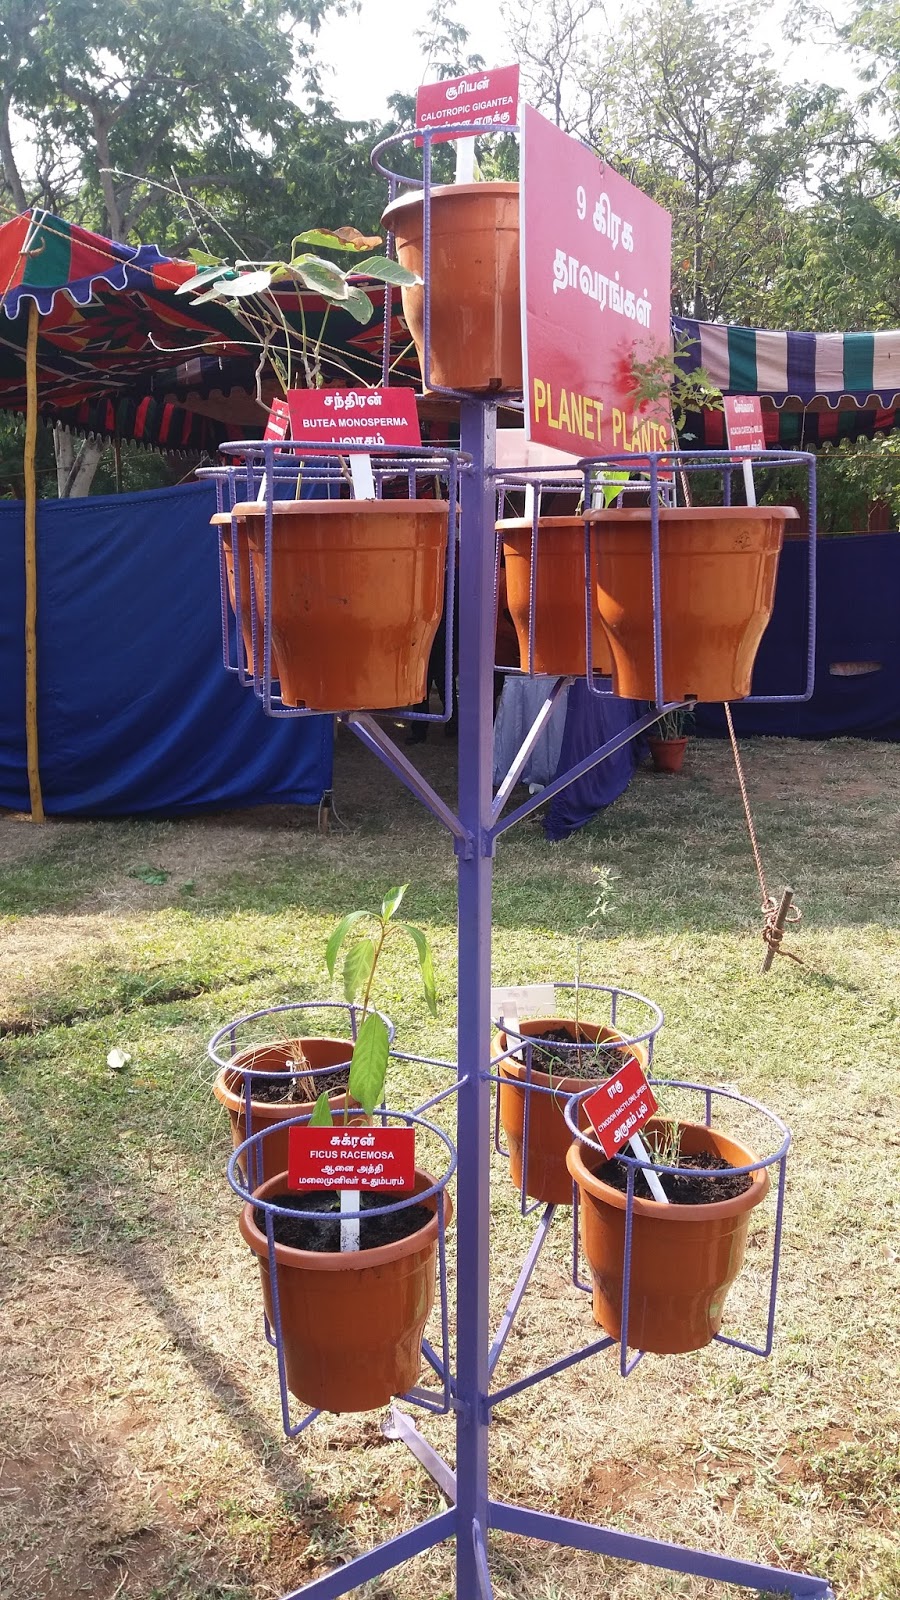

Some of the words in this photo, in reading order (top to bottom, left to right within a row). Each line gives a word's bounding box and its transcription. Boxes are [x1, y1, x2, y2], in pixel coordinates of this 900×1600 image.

[445, 76, 490, 100] சூரியன்
[421, 104, 470, 121] CALOTROPIC
[472, 96, 513, 111] GIGANTEA
[576, 185, 587, 220] 9
[593, 192, 634, 253] கிரக
[553, 248, 652, 329] தாவரங்கள்
[324, 392, 382, 410] சந்திரன்
[302, 418, 337, 428] BUTEA
[338, 417, 408, 427] MONOSPERMA
[533, 377, 604, 442] PLANET
[612, 407, 667, 459] PLANTS
[330, 1133, 375, 1148] சுக்ரன்
[310, 1150, 338, 1158] FICUS
[340, 1150, 394, 1159] RACEMOSA
[321, 1164, 354, 1175] ஆனை
[357, 1163, 383, 1174] அத்தி
